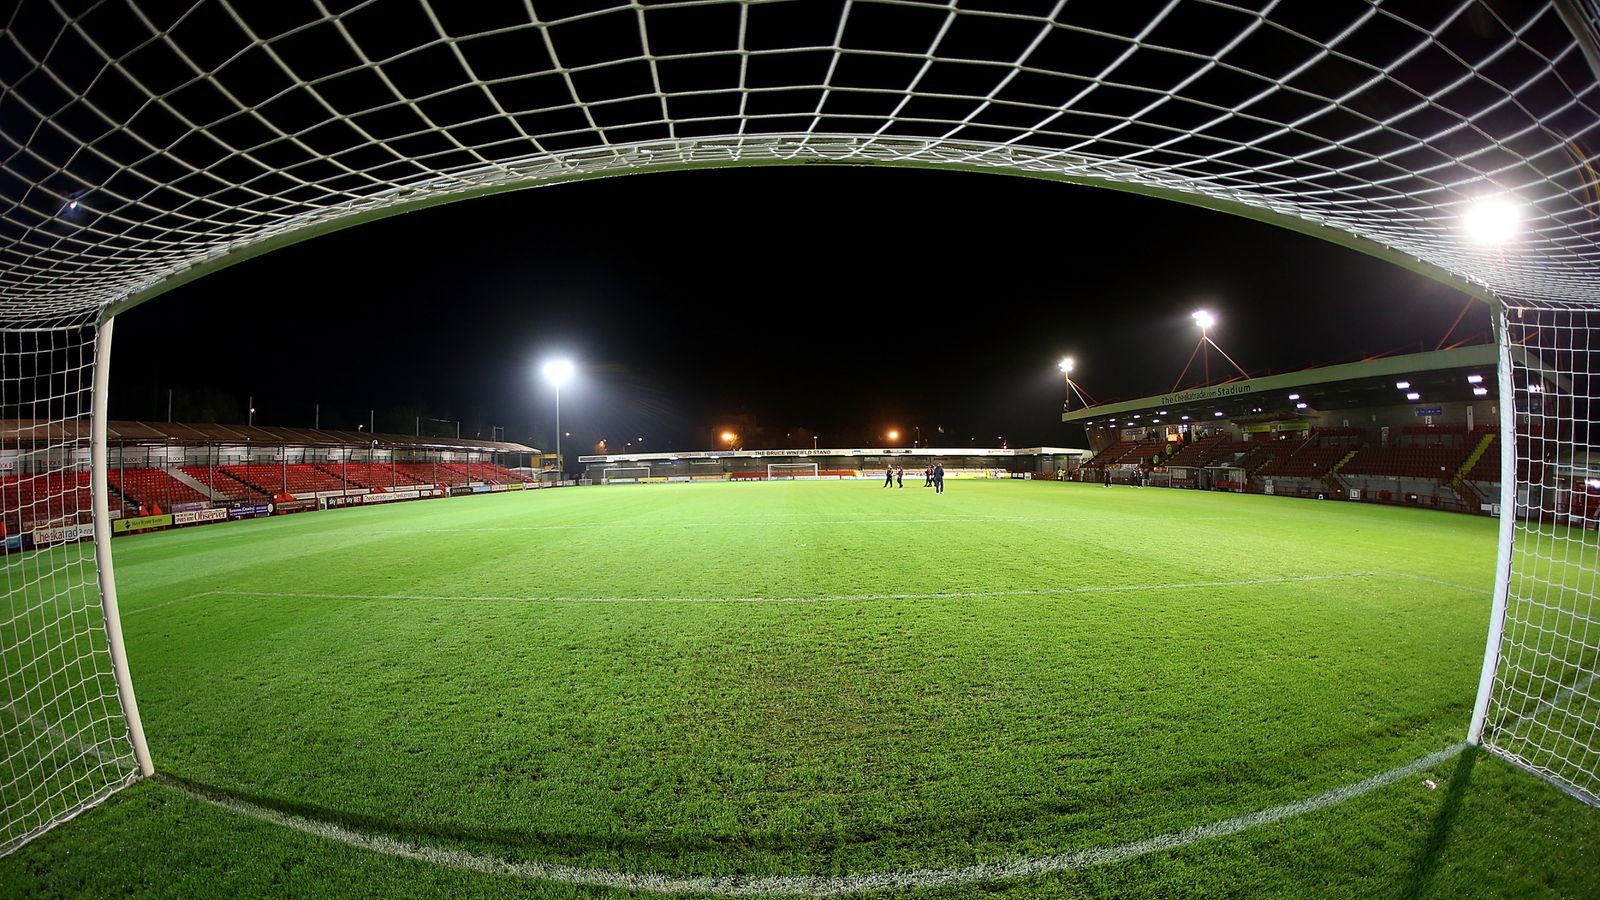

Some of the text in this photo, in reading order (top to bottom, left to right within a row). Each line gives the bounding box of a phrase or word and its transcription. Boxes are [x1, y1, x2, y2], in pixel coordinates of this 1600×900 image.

[1217, 384, 1251, 396] Stadium
[194, 511, 225, 521] Observer
[36, 526, 93, 543] Checkatrade.co
